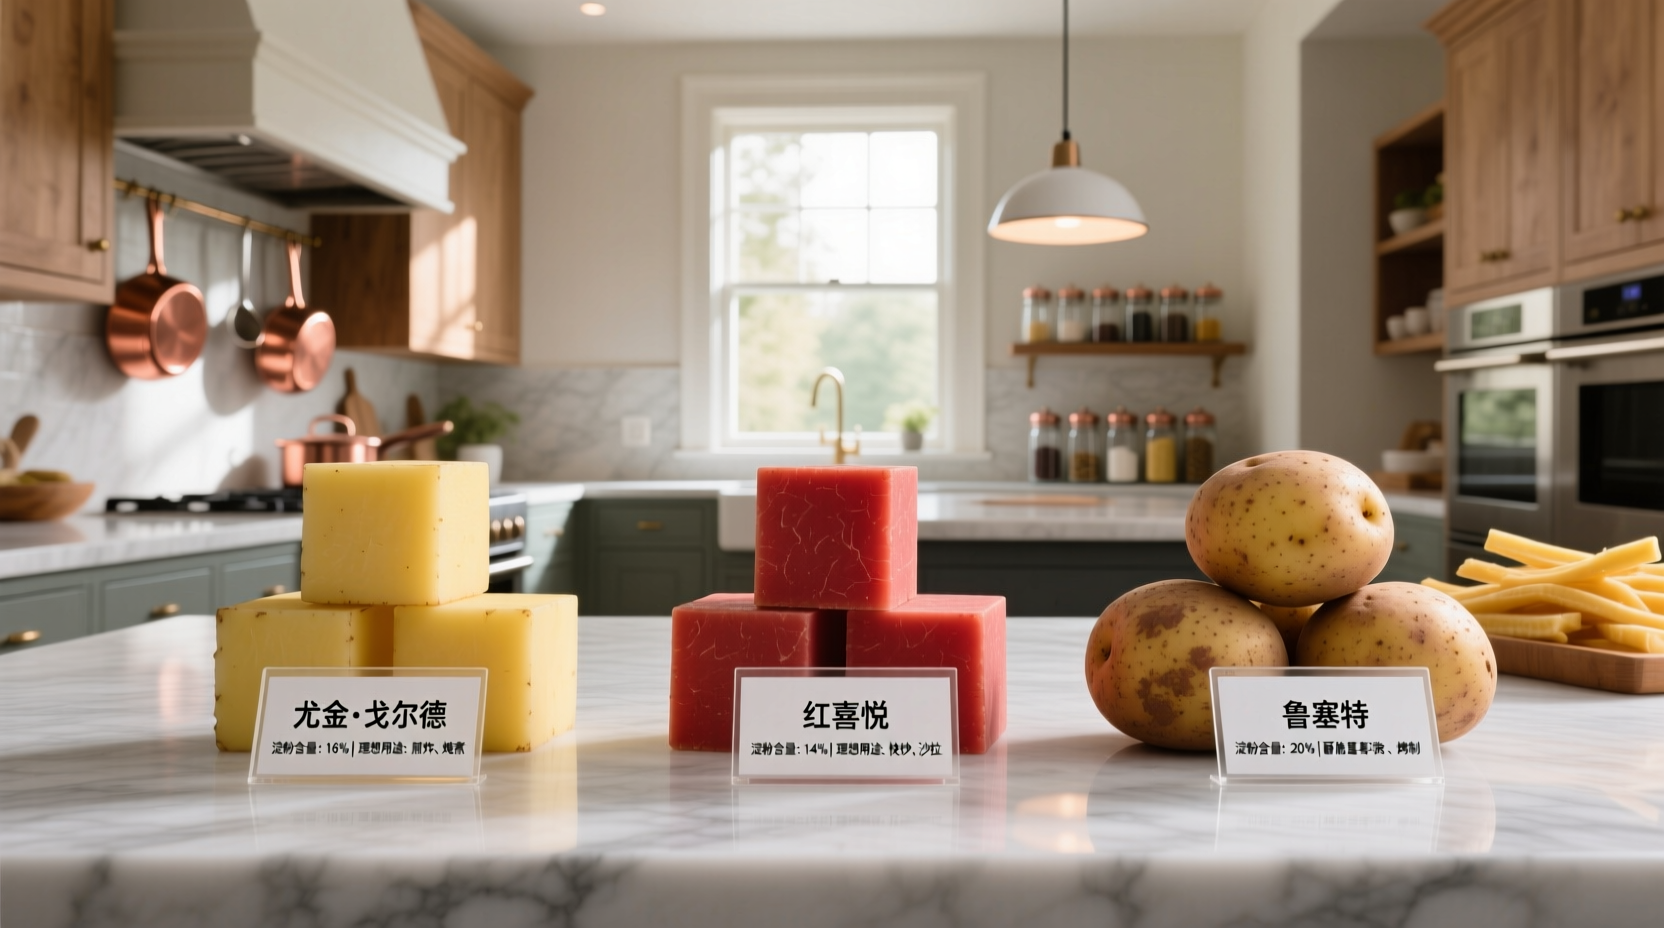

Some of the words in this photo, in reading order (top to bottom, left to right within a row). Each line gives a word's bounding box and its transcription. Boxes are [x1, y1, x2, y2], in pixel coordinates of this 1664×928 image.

[293, 699, 448, 730] 尤金·戈尔德
[802, 699, 890, 731] 红喜悦
[1282, 699, 1369, 730] 鲁塞特
